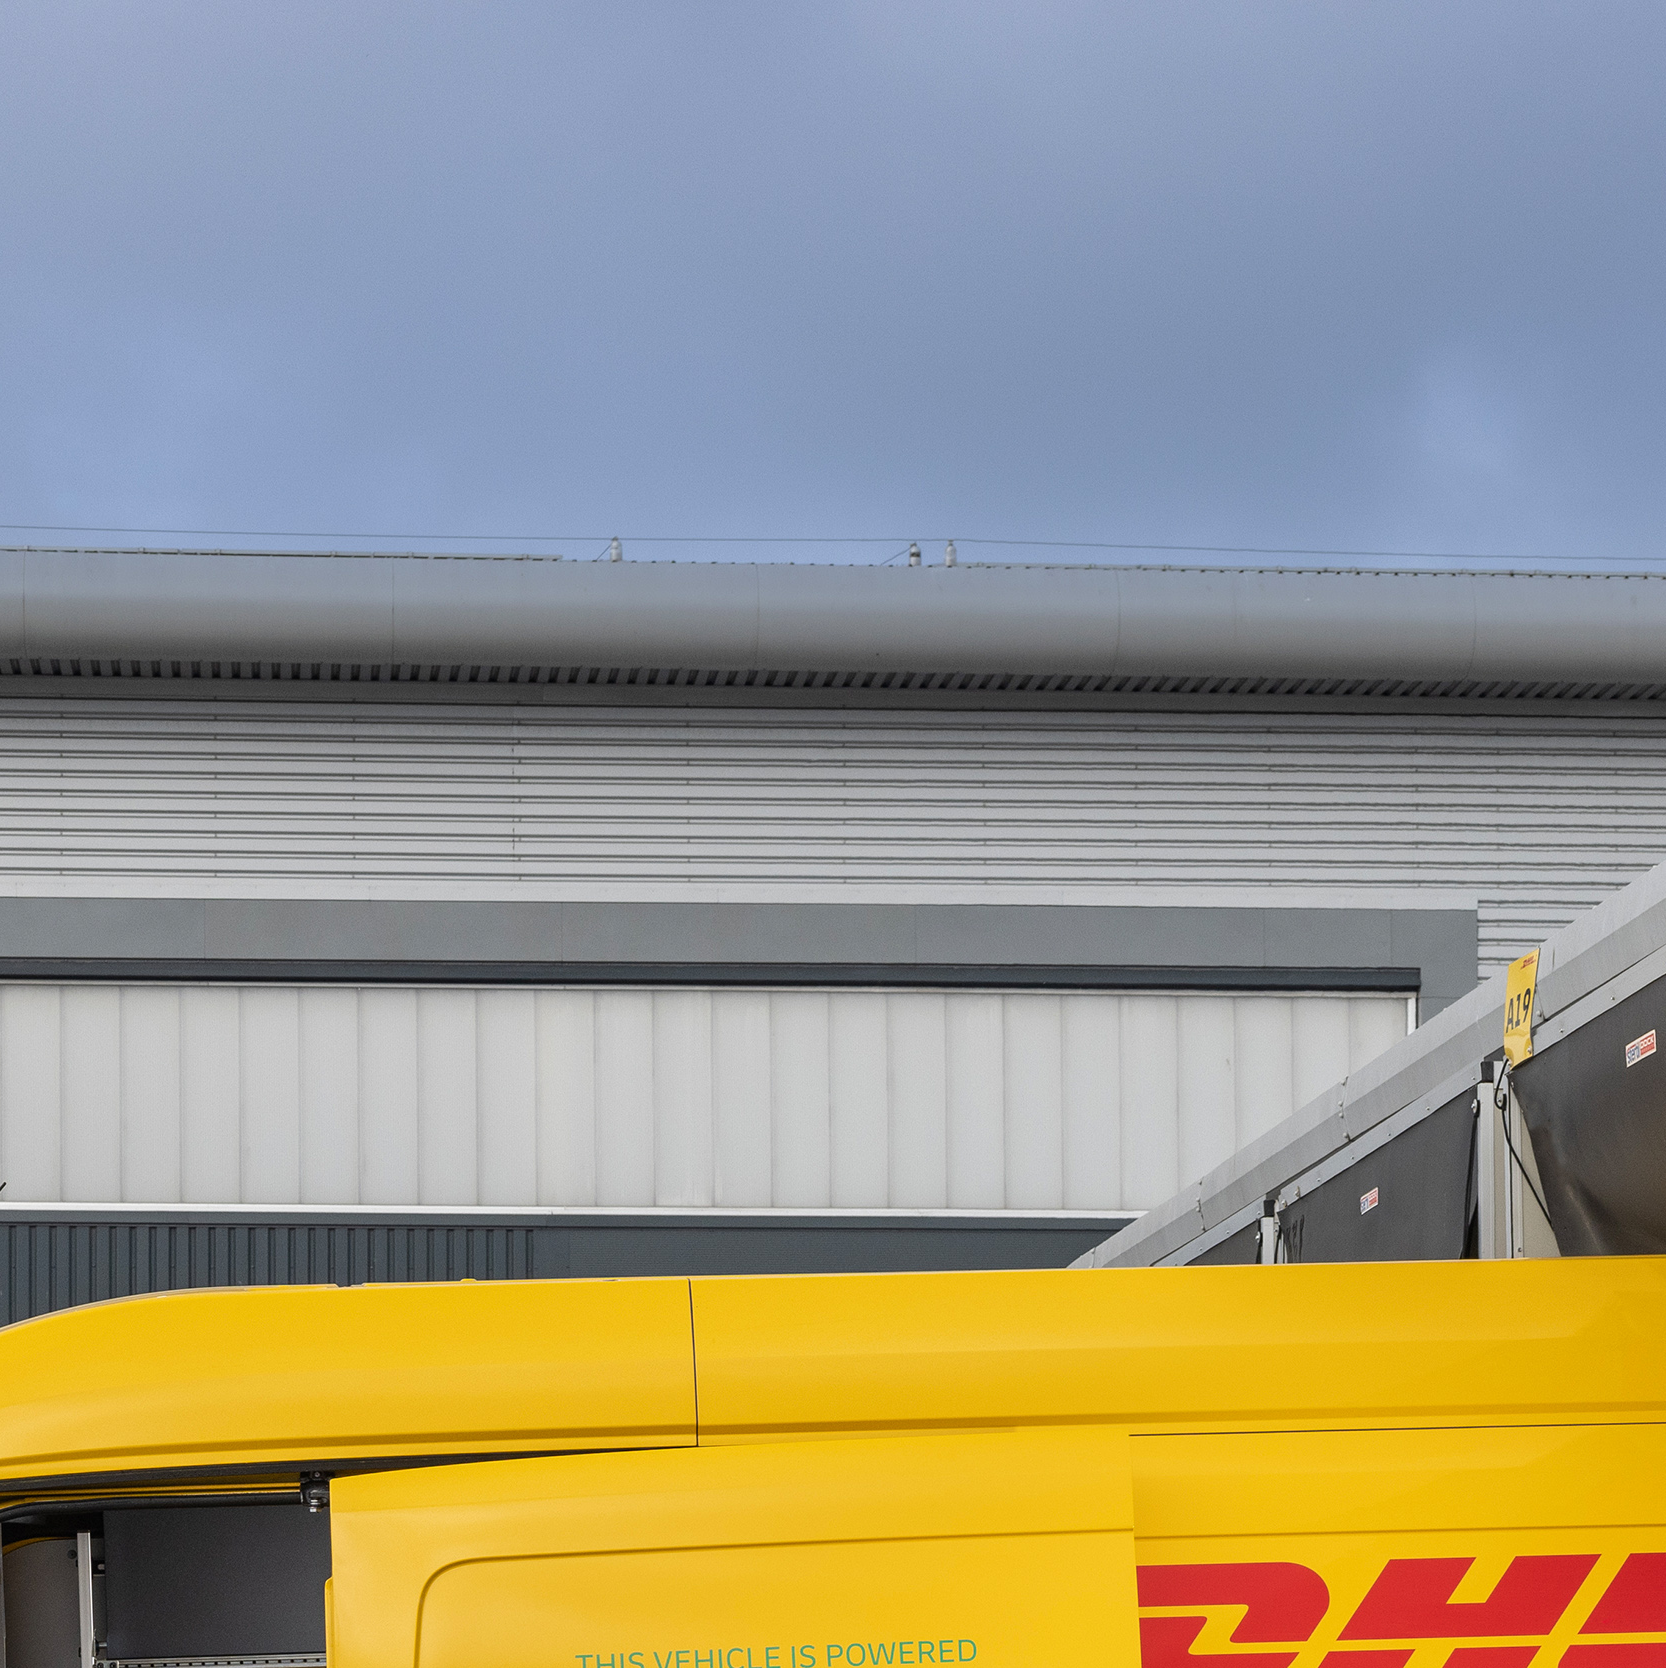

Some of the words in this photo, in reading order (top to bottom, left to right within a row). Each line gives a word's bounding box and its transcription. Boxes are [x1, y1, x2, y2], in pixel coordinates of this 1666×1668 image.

[1505, 987, 1531, 1034] A19
[791, 1645, 817, 1668] IS
[826, 1639, 978, 1668] POWERED
